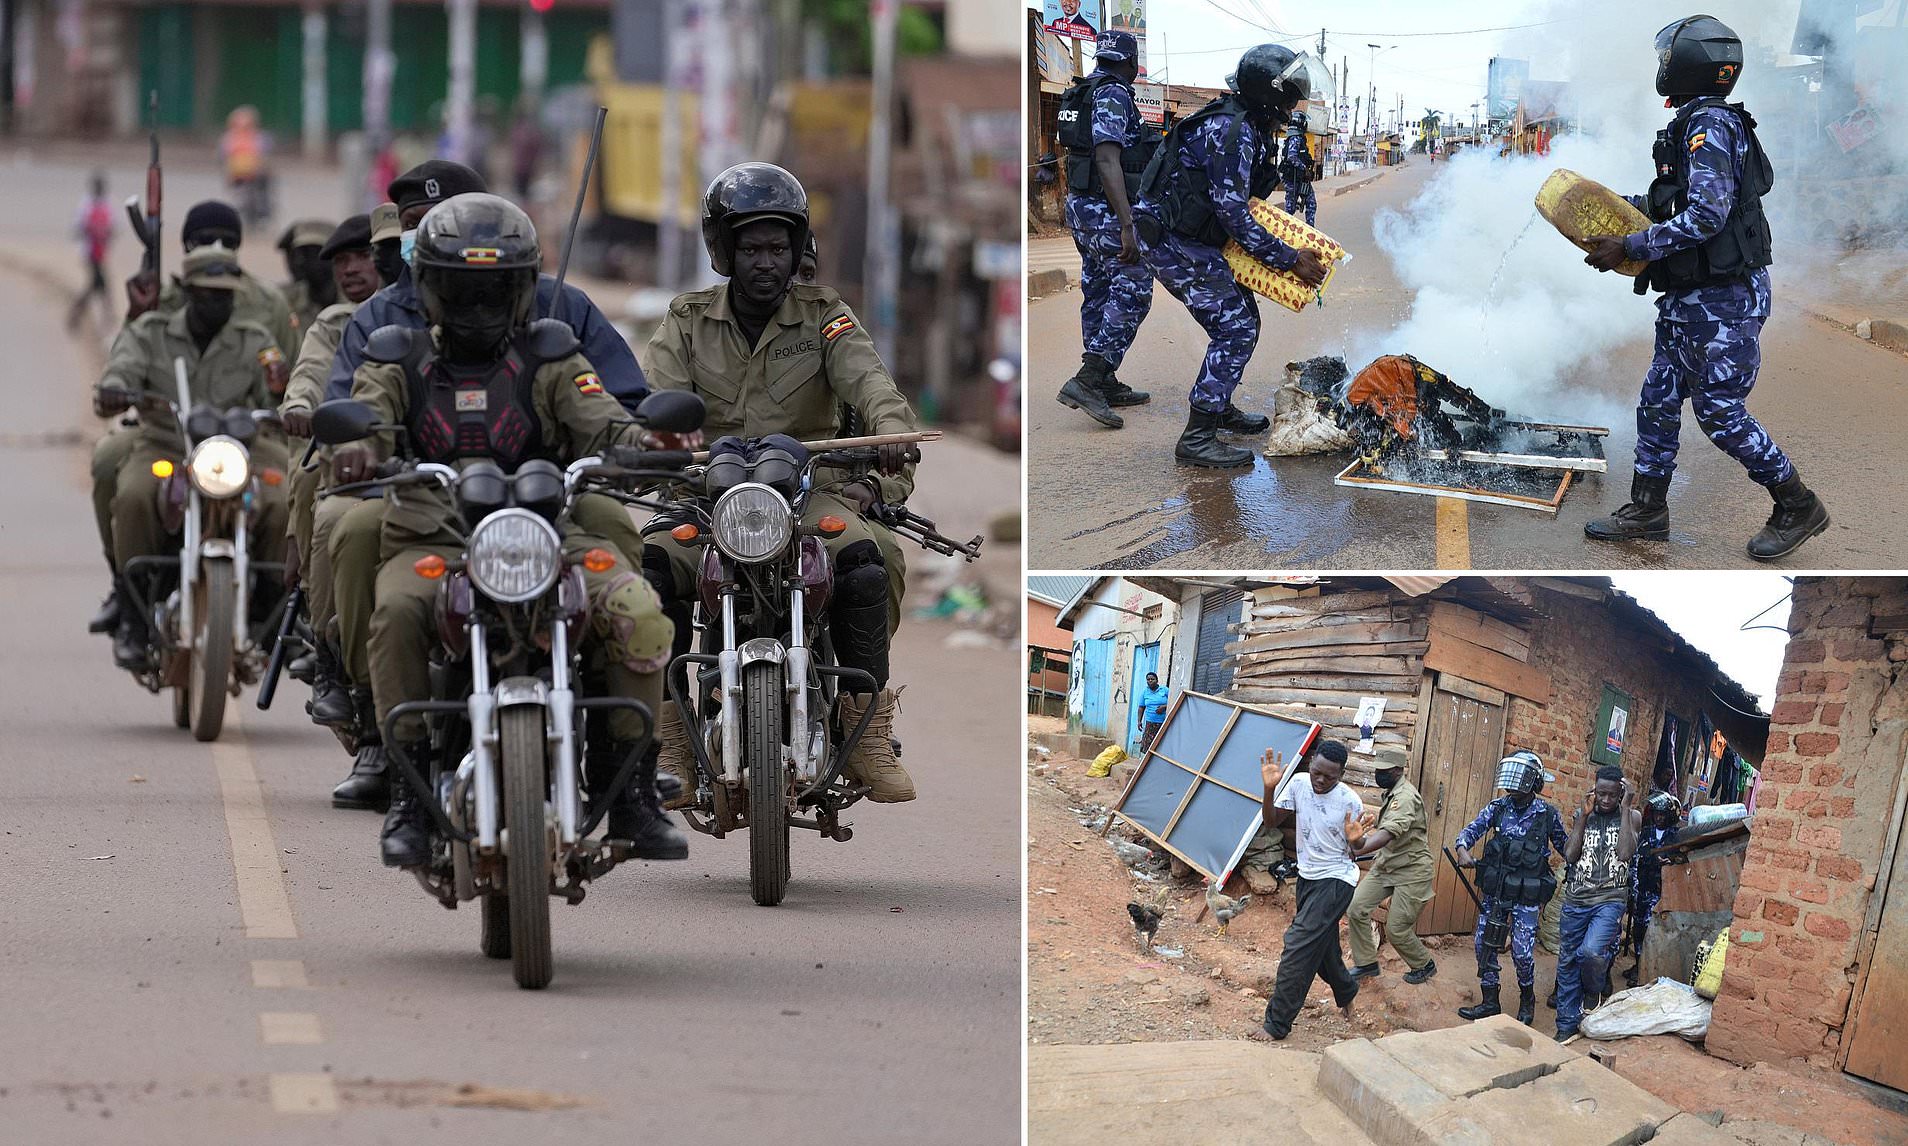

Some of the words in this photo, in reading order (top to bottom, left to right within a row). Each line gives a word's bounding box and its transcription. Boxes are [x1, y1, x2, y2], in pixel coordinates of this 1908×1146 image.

[1056, 22, 1067, 31] MP
[1098, 38, 1116, 48] POLICE
[1133, 97, 1160, 106] MAYOR
[775, 340, 813, 358] POLICE
